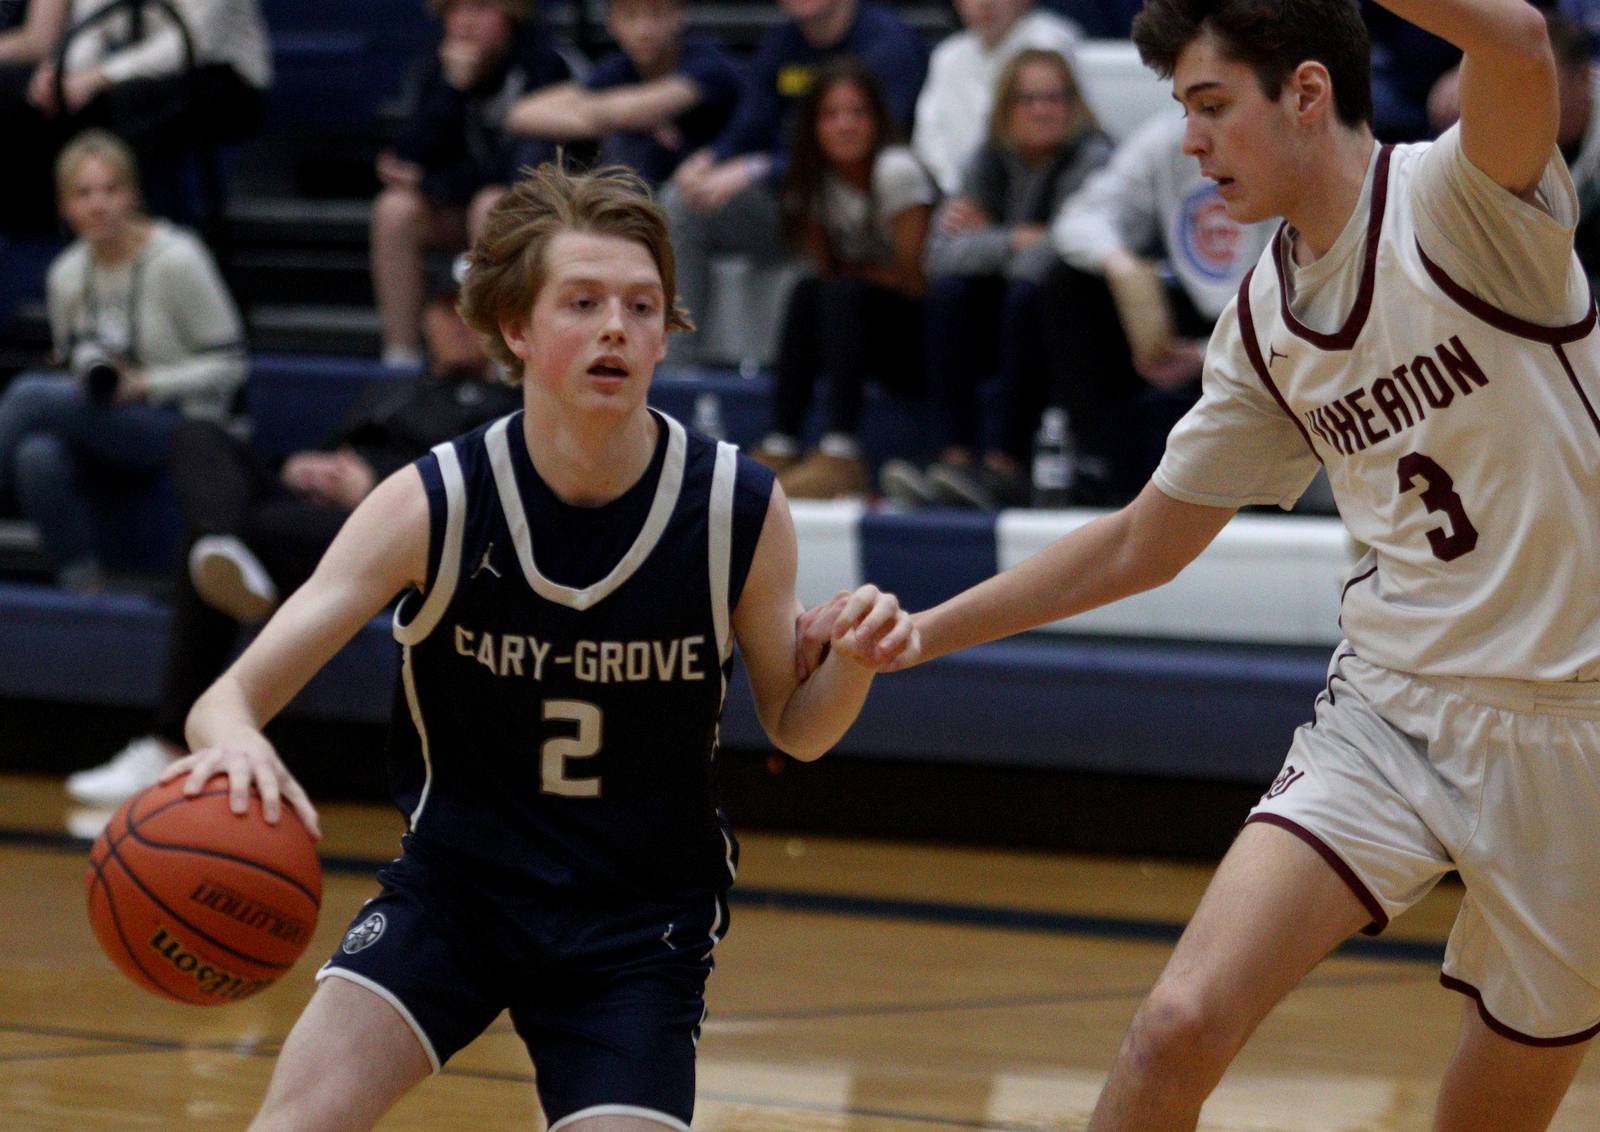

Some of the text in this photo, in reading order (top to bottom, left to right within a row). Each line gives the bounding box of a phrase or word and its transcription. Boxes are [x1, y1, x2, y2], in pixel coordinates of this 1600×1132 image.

[1397, 451, 1478, 562] 3
[454, 624, 706, 684] CARY-GROVE
[541, 700, 603, 797] 2
